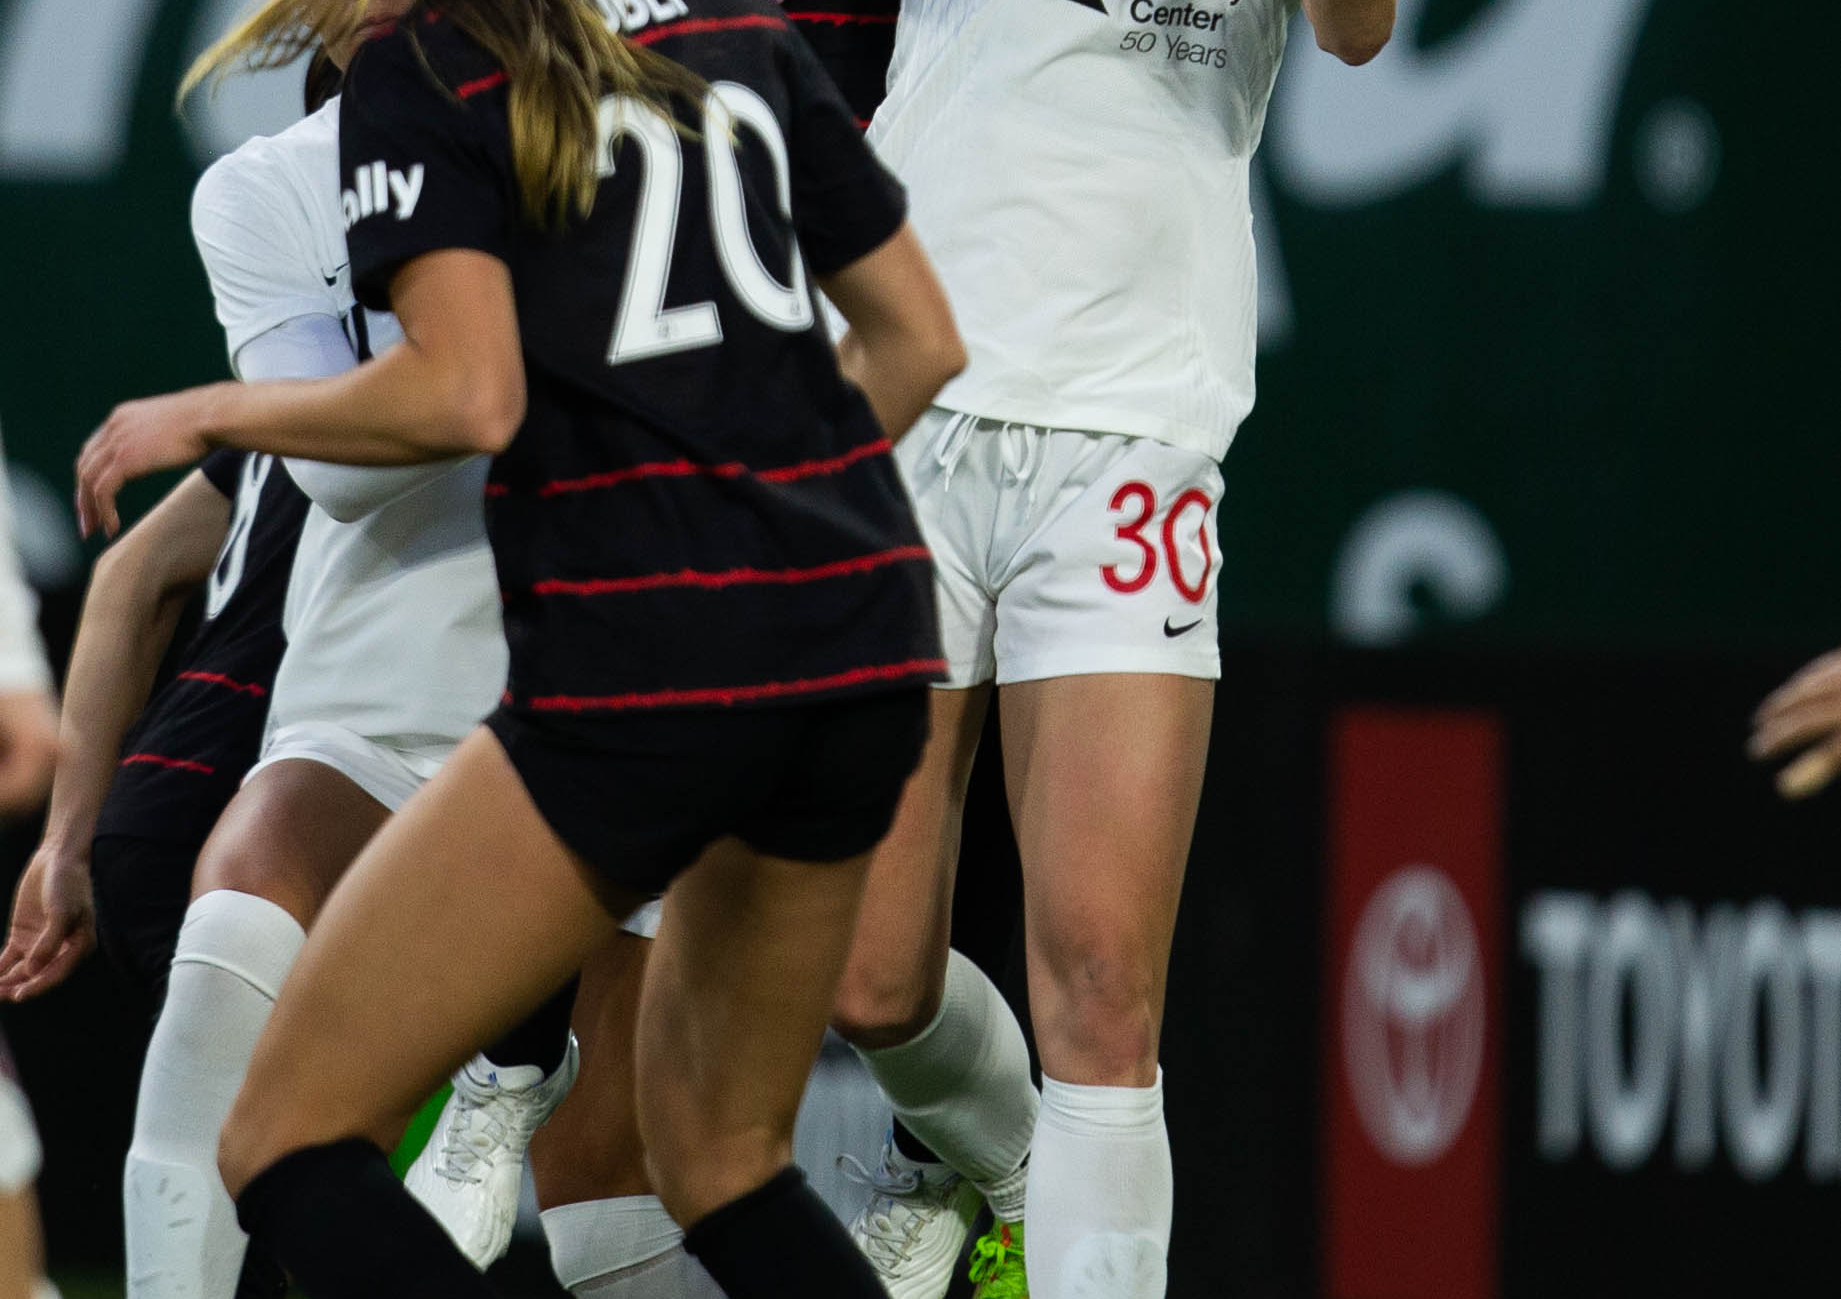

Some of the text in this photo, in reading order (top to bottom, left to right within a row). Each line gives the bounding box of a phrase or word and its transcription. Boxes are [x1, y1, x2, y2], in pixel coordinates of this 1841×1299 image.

[1120, 31, 1228, 69] 50 Years
[593, 79, 815, 366] 20
[1100, 479, 1213, 606] 30
